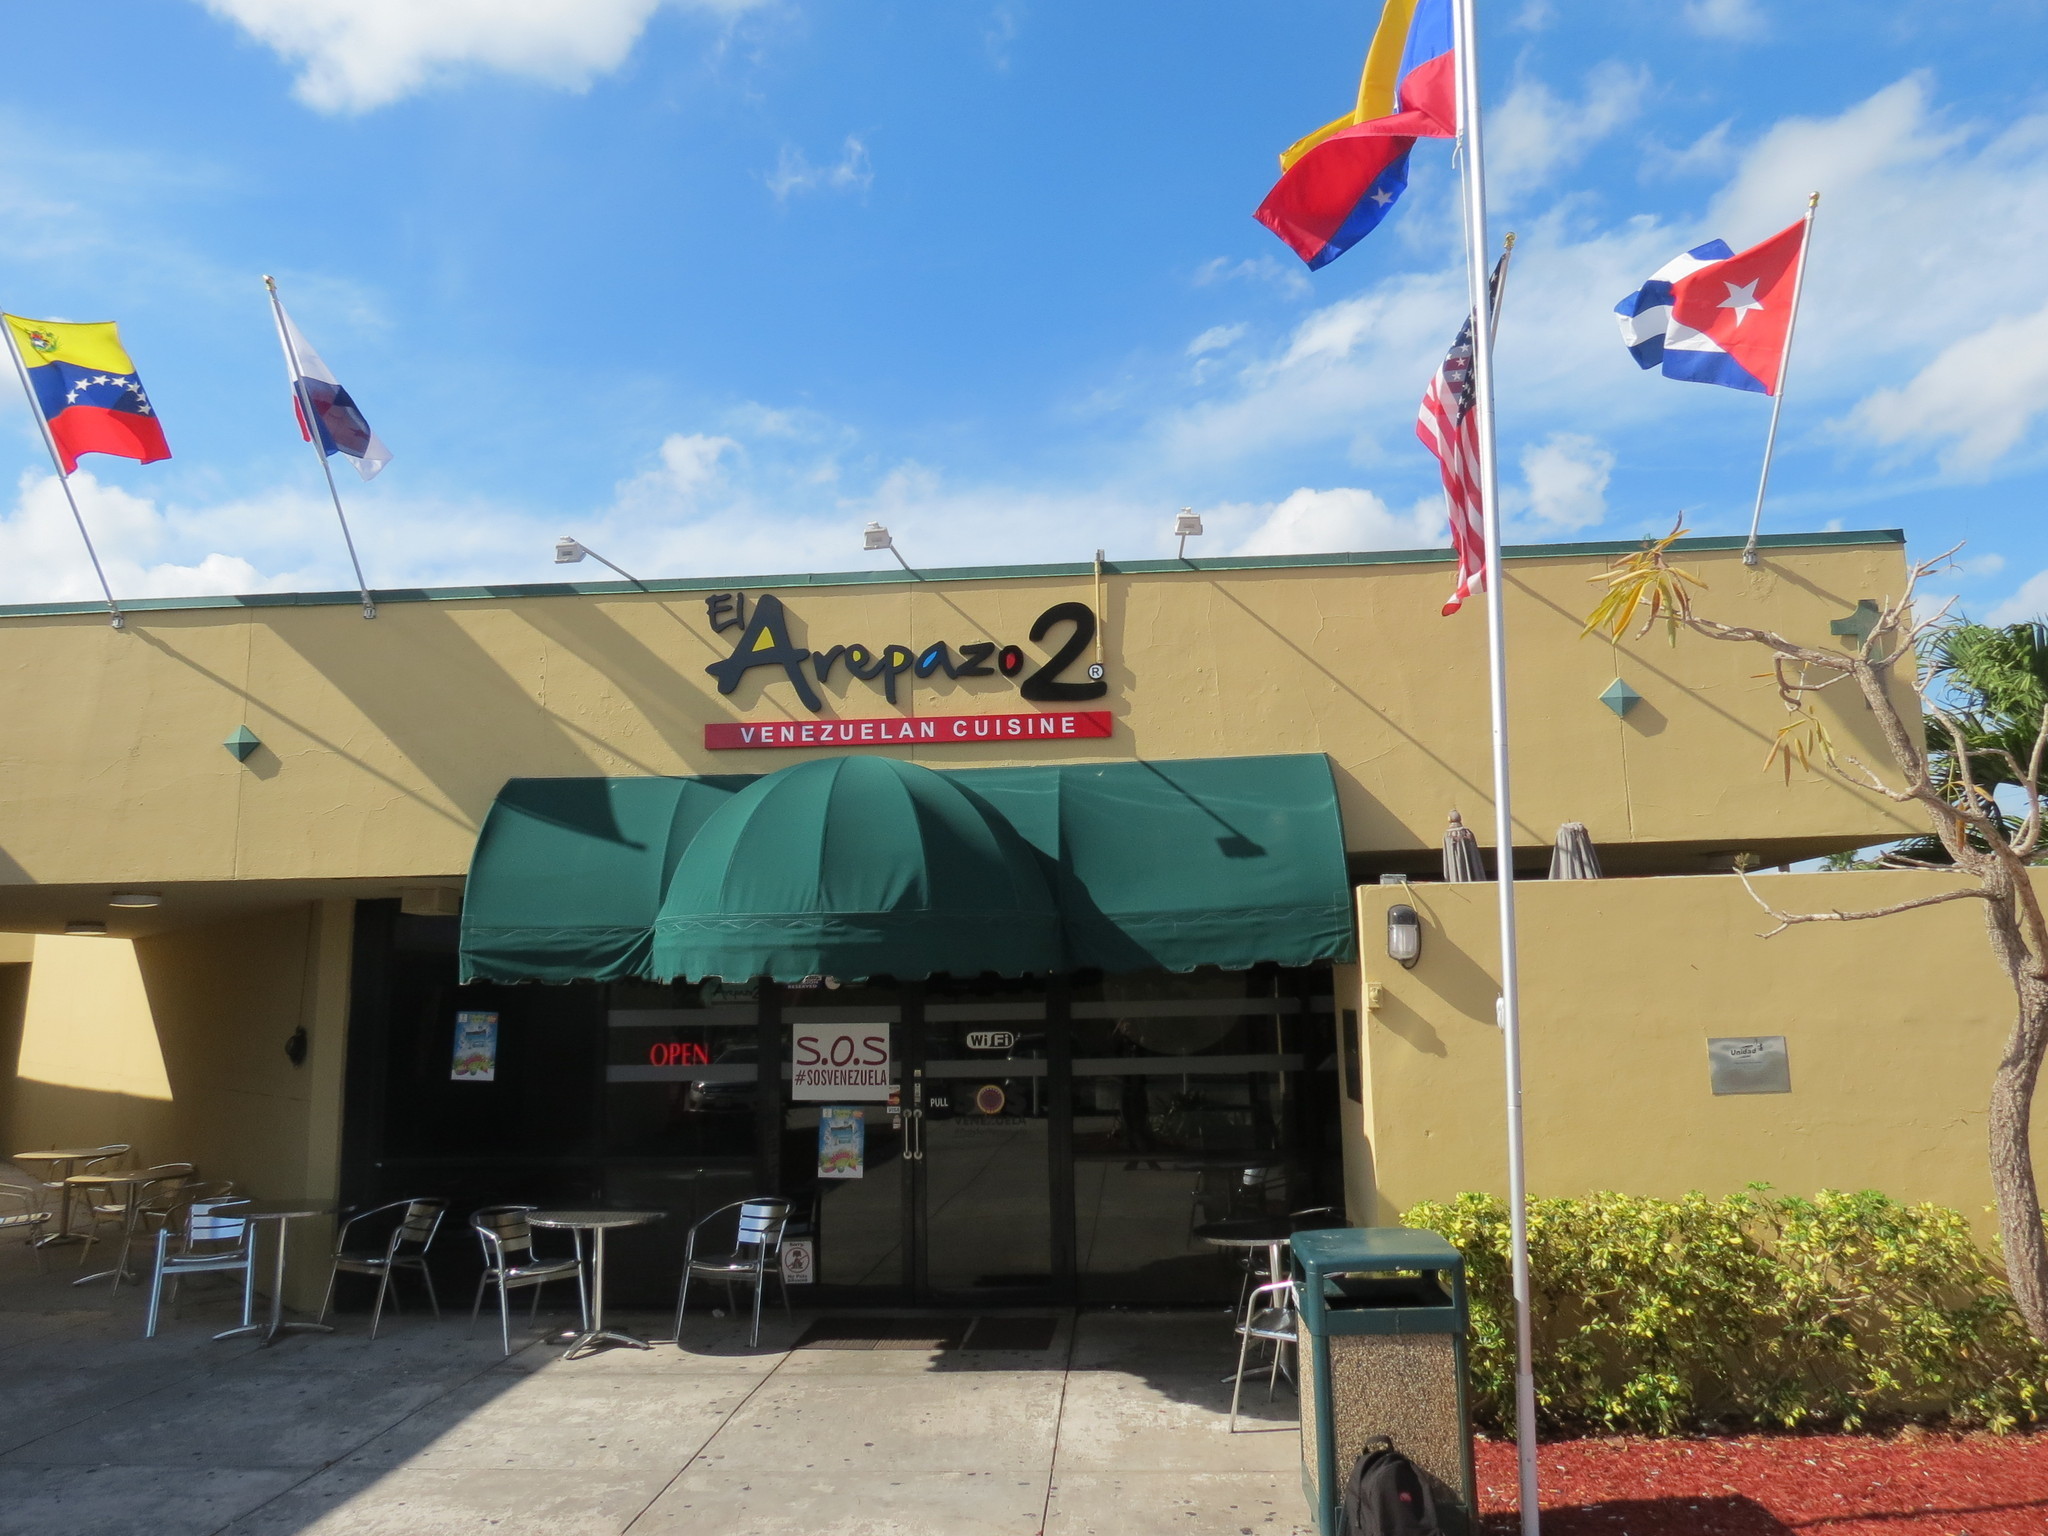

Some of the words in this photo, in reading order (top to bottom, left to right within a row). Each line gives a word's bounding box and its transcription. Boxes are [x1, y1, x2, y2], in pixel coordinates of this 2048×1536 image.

[705, 592, 745, 633] El
[705, 594, 1024, 713] Arepazo
[1020, 602, 1108, 701] 2
[740, 721, 936, 744] VENEZUELAN
[953, 717, 1076, 737] CUISINE
[650, 1042, 709, 1067] OPEN
[796, 1035, 888, 1067] S.O.S
[1730, 1048, 1757, 1056] Unidad
[794, 1069, 887, 1086] #SOSVENEZUELA
[930, 1098, 949, 1107] PULL
